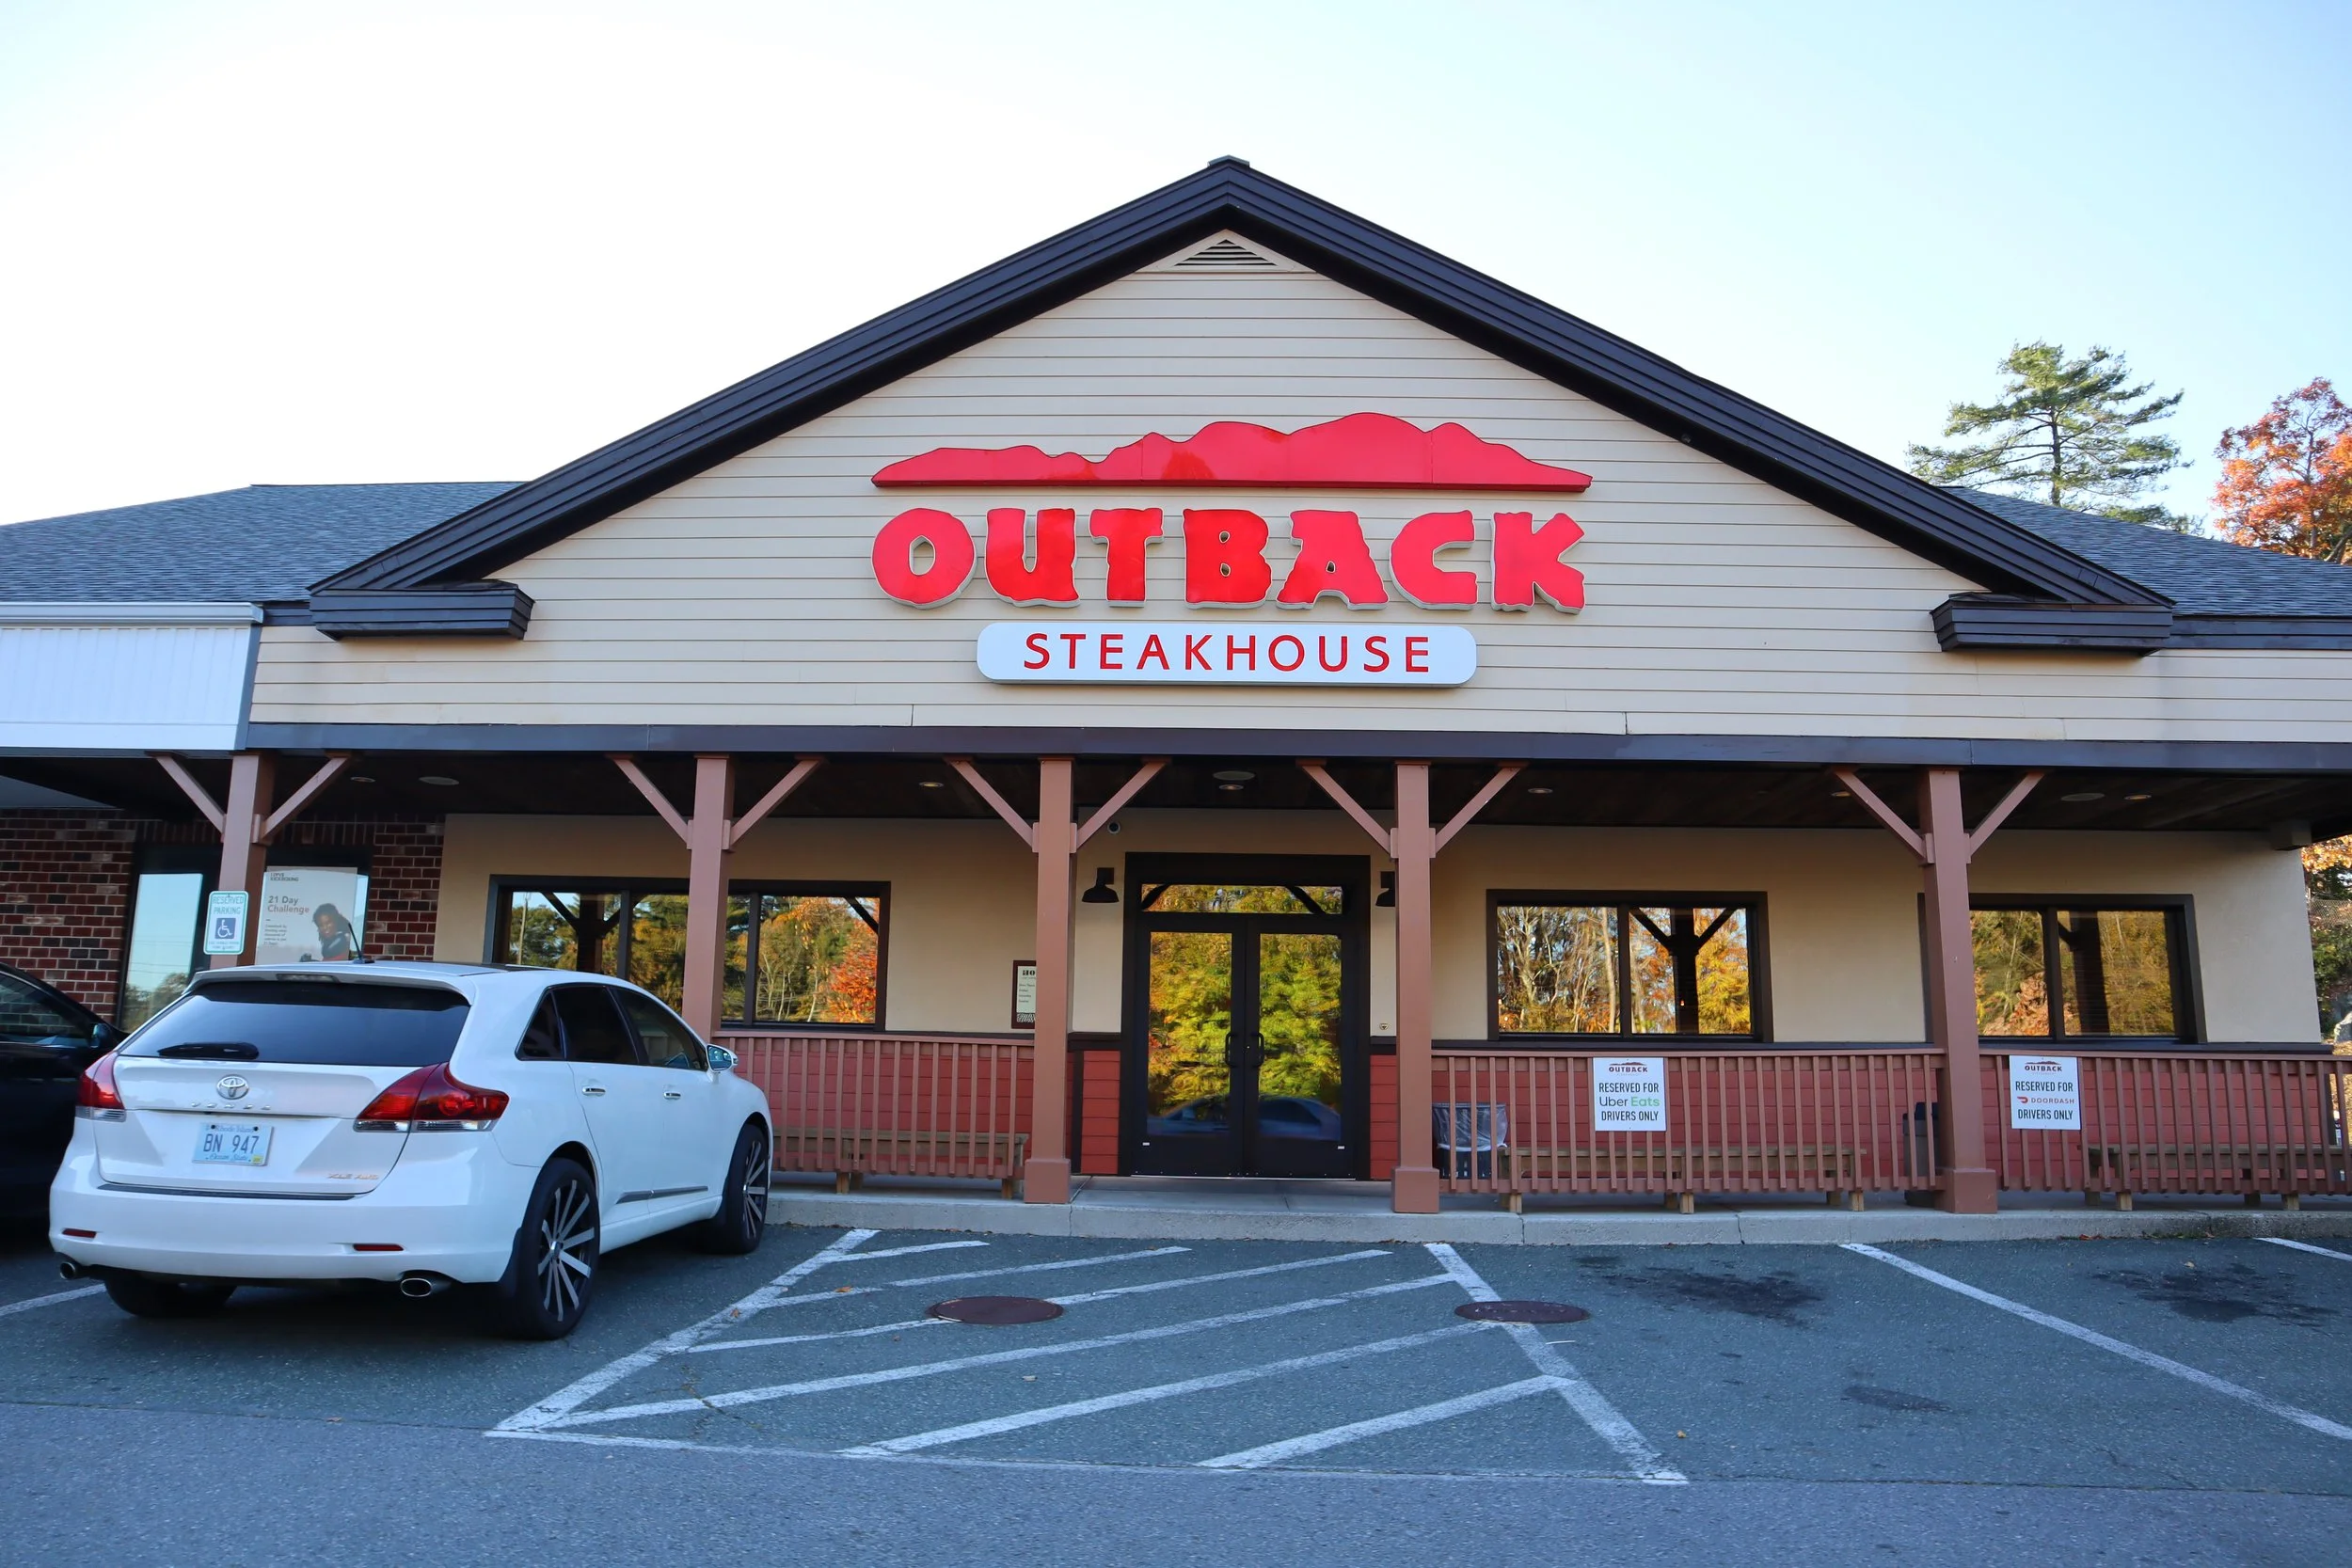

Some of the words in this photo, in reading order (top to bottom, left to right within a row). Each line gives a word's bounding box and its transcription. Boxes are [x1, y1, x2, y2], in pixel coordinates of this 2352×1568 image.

[871, 508, 1586, 613] OUTBACK
[1023, 633, 1431, 673] STEAKHOUSE
[212, 895, 244, 904] RESERVED
[268, 895, 278, 904] 21
[281, 895, 299, 906] Day
[267, 905, 310, 915] Challenge
[1598, 1083, 1641, 1093] RESERVED
[1643, 1083, 1660, 1093] FOR
[2015, 1081, 2056, 1092] RESERVED
[2058, 1082, 2074, 1092] FOR
[1599, 1096, 1629, 1107] Uber
[1630, 1096, 1661, 1107] Eats
[1601, 1111, 1637, 1121] DRIVERS
[1638, 1111, 1659, 1121] ONLY
[2018, 1109, 2052, 1119] DRIVERS
[2053, 1110, 2074, 1120] ONLY
[203, 1133, 223, 1152] BN
[231, 1134, 260, 1154] 947
